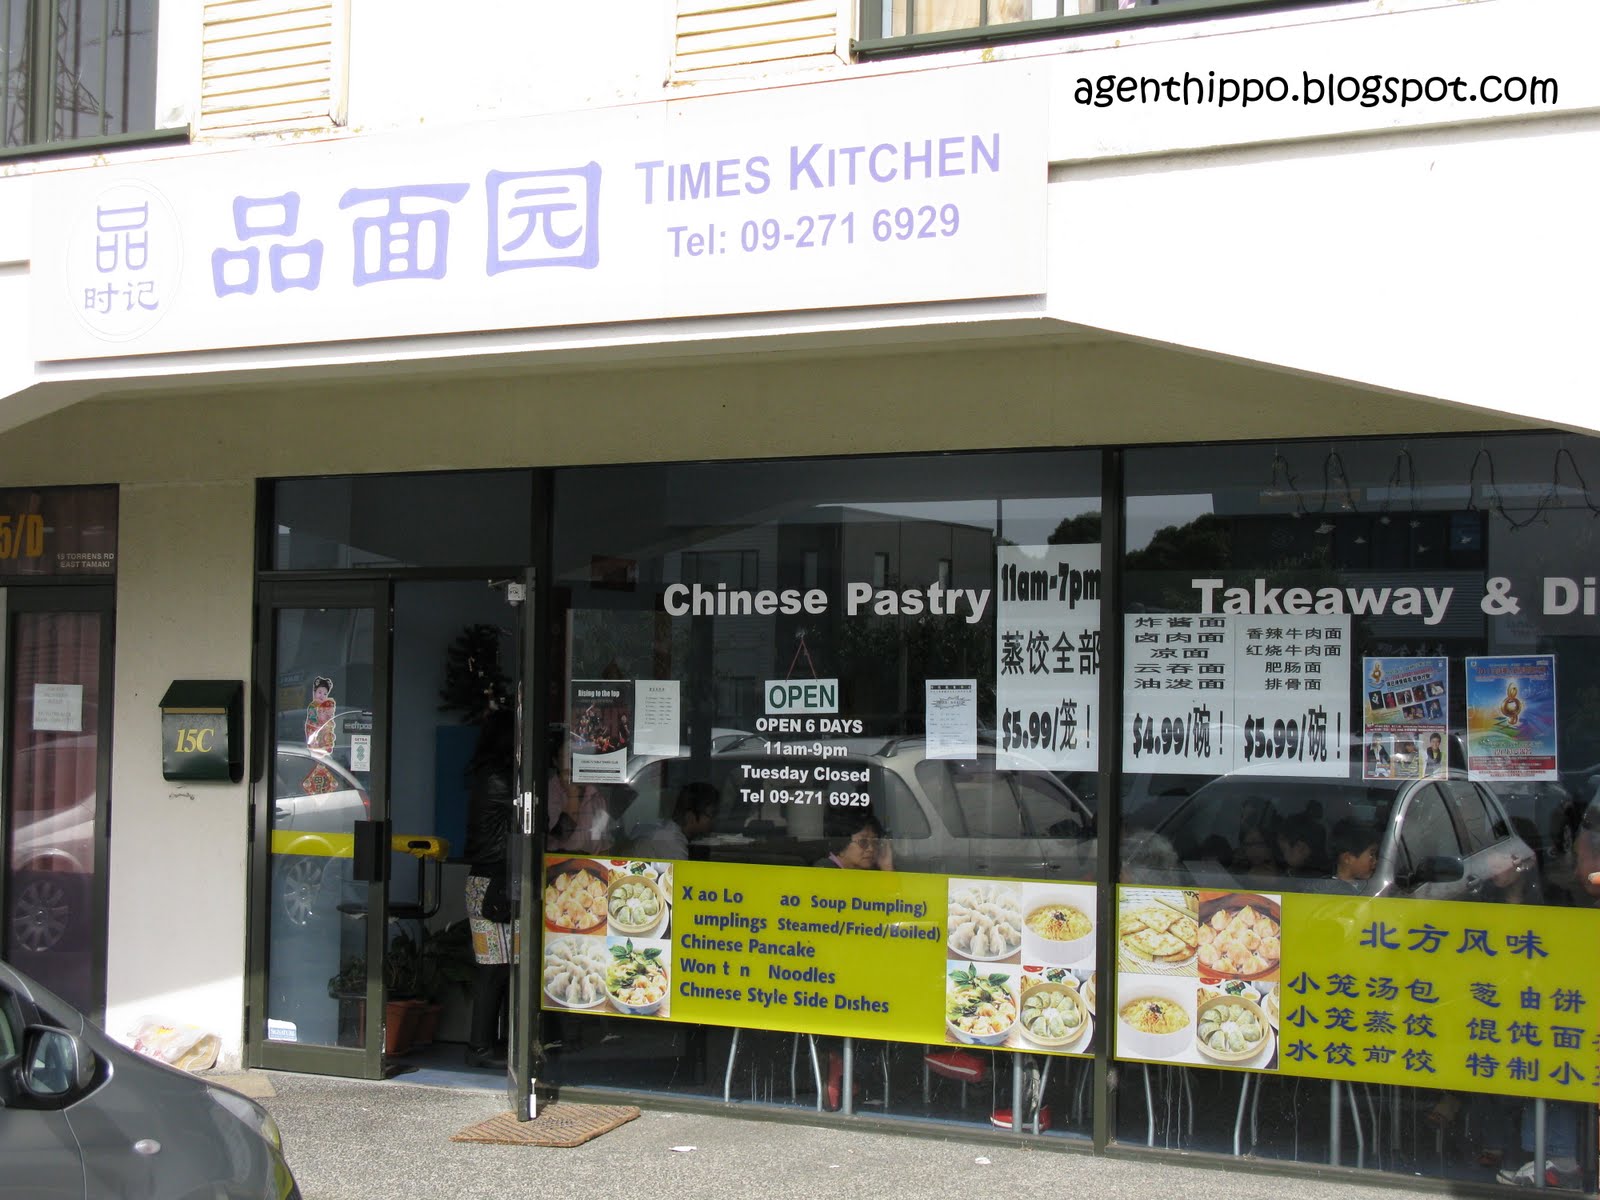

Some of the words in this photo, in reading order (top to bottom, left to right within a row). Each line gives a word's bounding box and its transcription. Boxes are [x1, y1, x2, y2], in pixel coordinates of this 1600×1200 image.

[634, 155, 771, 205] TIMES
[789, 133, 1001, 191] KITCHEN
[211, 160, 602, 298] 品面园
[667, 224, 728, 258] Tel:
[740, 211, 855, 253] 09-271
[872, 203, 960, 242] 6929
[84, 280, 160, 314] 时记
[67, 552, 102, 560] TORRENS
[1001, 562, 1101, 610] 11am-7pm
[663, 582, 829, 617] Chinese
[847, 582, 991, 624] Pastry
[1191, 577, 1454, 626] Takeaway
[1481, 577, 1521, 616] &
[1543, 577, 1597, 616] Di
[1134, 617, 1226, 628] 炸酱面
[1246, 627, 1342, 640] 香辣牛肉面
[1134, 632, 1225, 643] 卤肉面
[1246, 644, 1341, 656] 红烧牛肉面
[1001, 629, 1100, 675] 蒸饺全部
[1134, 663, 1225, 674] 云吞面
[1265, 661, 1321, 673] 肥肠面
[1265, 678, 1321, 690] 排骨面
[769, 685, 836, 709] OPEN
[755, 717, 802, 732] OPEN
[805, 719, 816, 732] 6
[819, 719, 863, 733] DAYS
[175, 728, 215, 753] 15C
[763, 741, 848, 759] 11am-9pm
[741, 765, 809, 783] Tuesday
[813, 766, 871, 782] Closed
[740, 788, 765, 803] Tel
[769, 789, 823, 804] 09-271
[829, 791, 871, 807] 6929
[811, 895, 847, 913] Soup
[851, 897, 928, 918] Dumpling)
[694, 912, 767, 933] umplings
[777, 917, 941, 943] Steamed/Fried/Boiled)
[680, 933, 743, 952] Chinese
[749, 938, 815, 958] Pancake
[1359, 921, 1549, 960] 北方风味
[680, 957, 716, 974] Won
[768, 963, 836, 984] Noodles
[747, 987, 788, 1008] Style
[793, 990, 828, 1008] Side
[1288, 971, 1439, 1004] 小笼汤包
[1286, 1004, 1437, 1039] 小笼蒸饺
[1466, 1017, 1600, 1050] 馄饨面
[1466, 1052, 1600, 1086] 特制小
